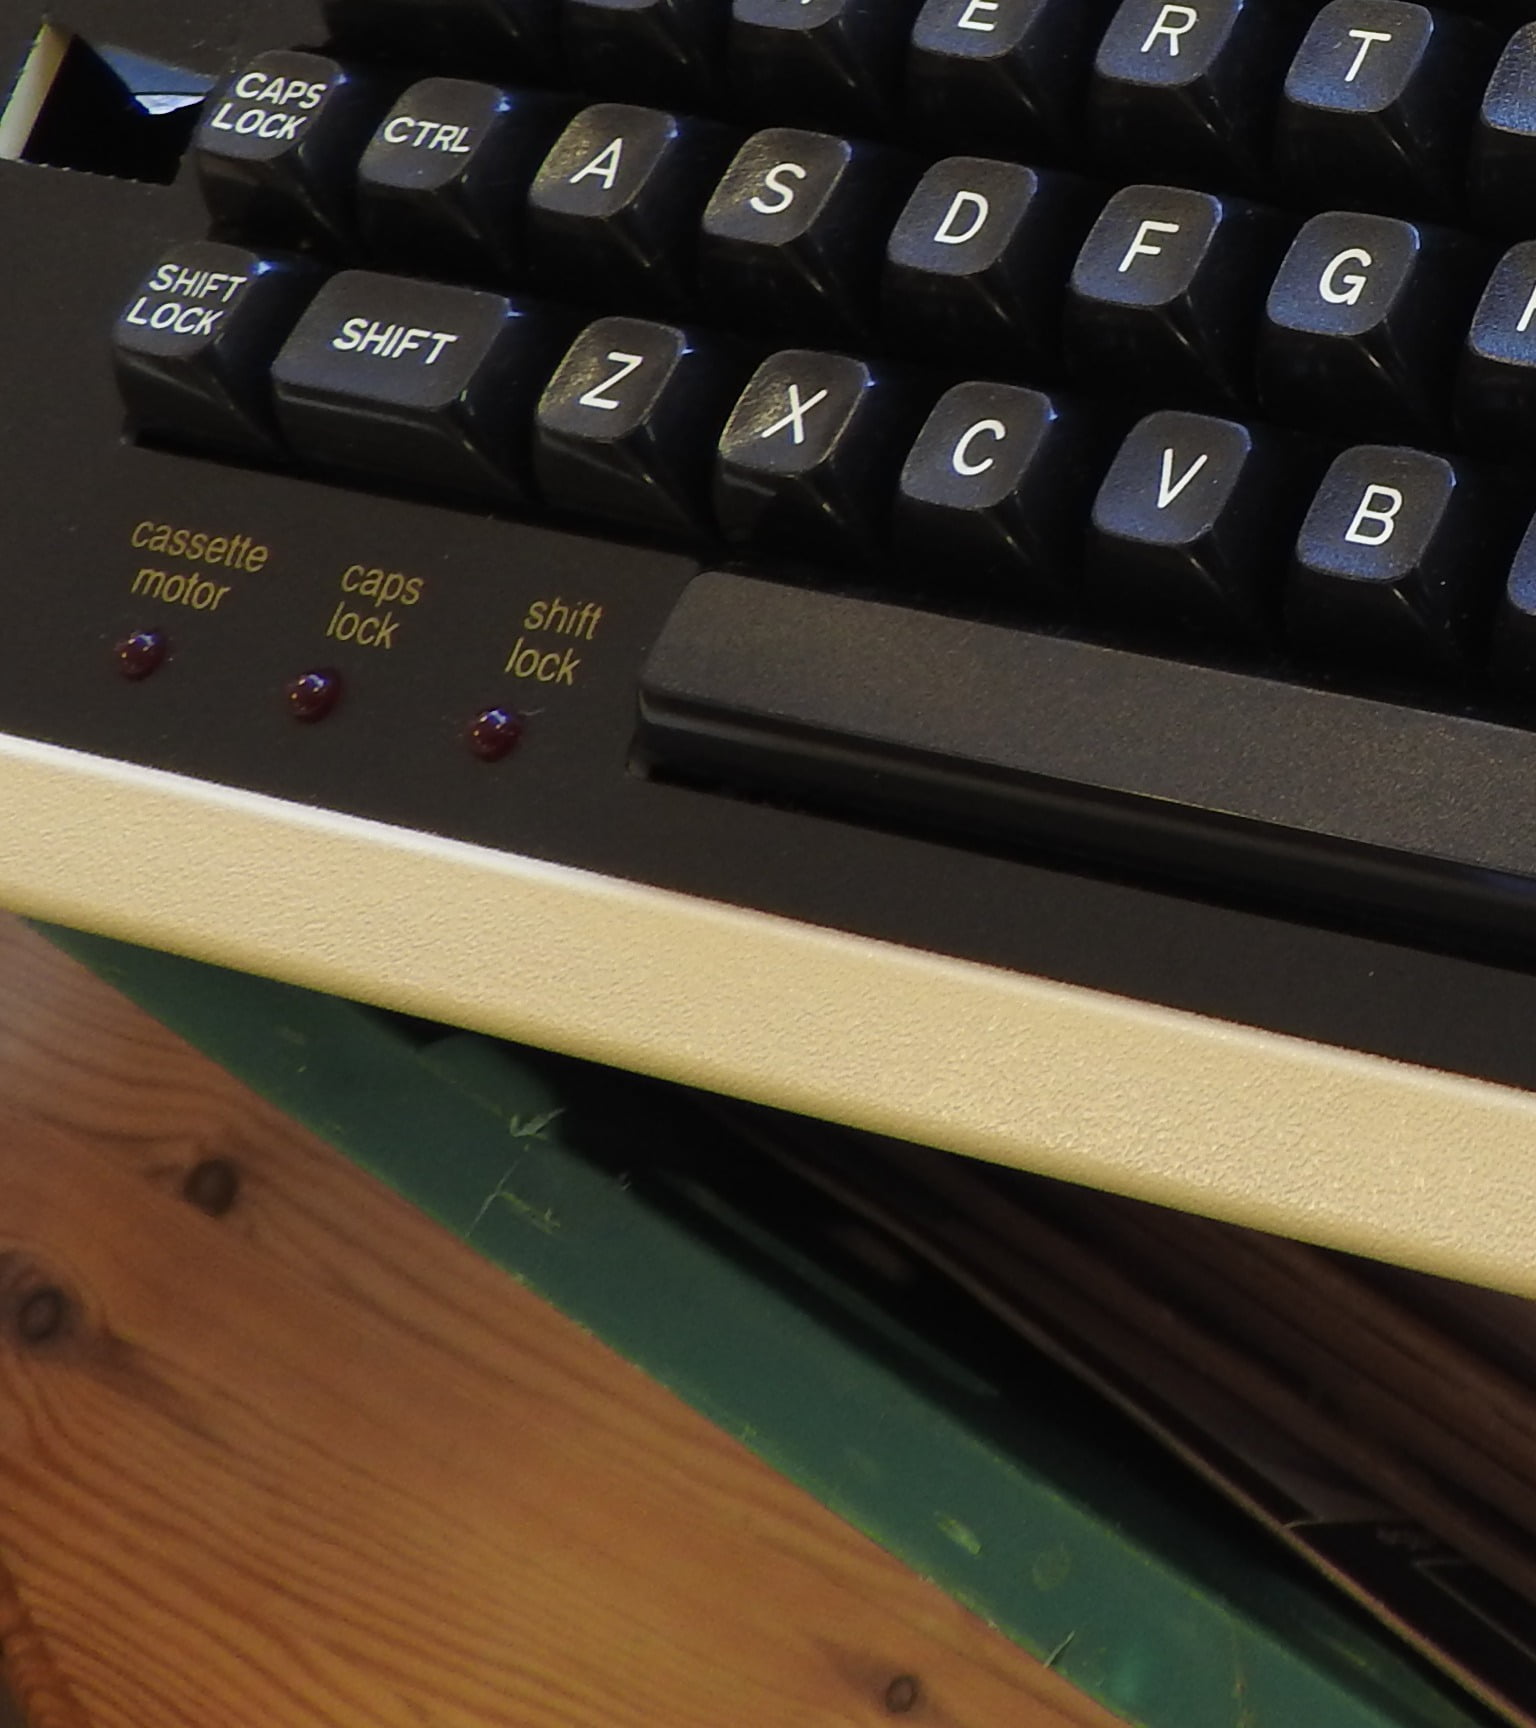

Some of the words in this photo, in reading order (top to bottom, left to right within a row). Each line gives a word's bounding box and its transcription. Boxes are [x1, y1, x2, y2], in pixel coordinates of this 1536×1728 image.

[1141, 5, 1196, 56] R
[1345, 30, 1391, 81] T
[235, 73, 326, 108] CAPS
[211, 108, 306, 141] LOCK
[384, 117, 469, 152] CTRL
[570, 139, 622, 188] A
[749, 164, 805, 213] S
[934, 191, 988, 243] D
[1119, 221, 1179, 272] F
[148, 264, 246, 303] SHIFT
[1320, 249, 1371, 305] G
[127, 297, 223, 334] LOCK
[333, 319, 457, 364] SHIFT
[580, 352, 642, 409] Z
[761, 385, 827, 443] X
[953, 420, 1005, 475] C
[1158, 449, 1207, 508] V
[1345, 485, 1401, 545] B
[131, 519, 268, 573] cassette
[131, 568, 230, 612] motor
[341, 563, 424, 607] caps
[326, 604, 400, 649] lock
[524, 598, 602, 641] shift
[505, 638, 581, 685] lock
